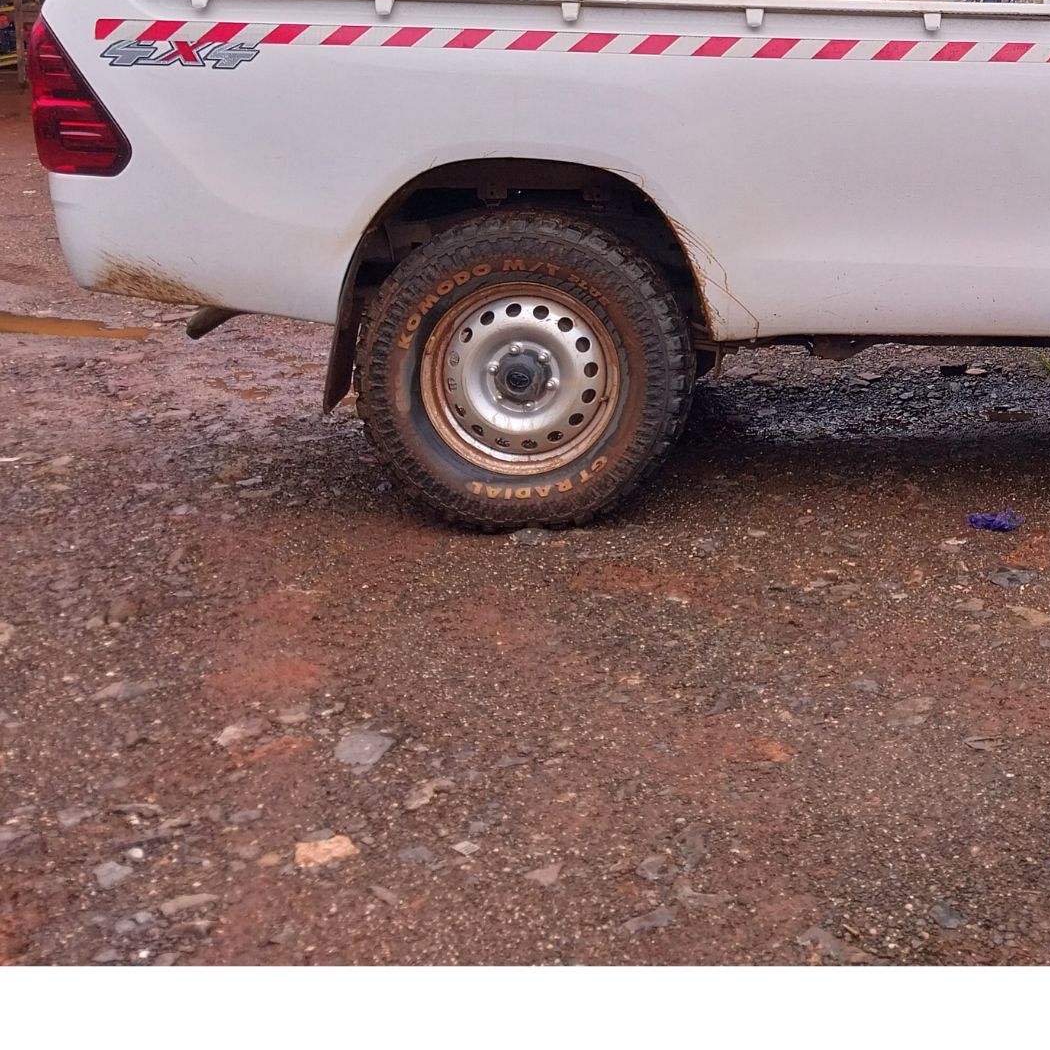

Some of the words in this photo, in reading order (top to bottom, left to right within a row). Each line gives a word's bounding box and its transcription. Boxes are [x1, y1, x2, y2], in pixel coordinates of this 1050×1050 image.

[398, 263, 492, 350] KOMODO
[502, 260, 560, 278] M/T
[579, 455, 609, 485] GT
[470, 478, 576, 500] RADIAL
